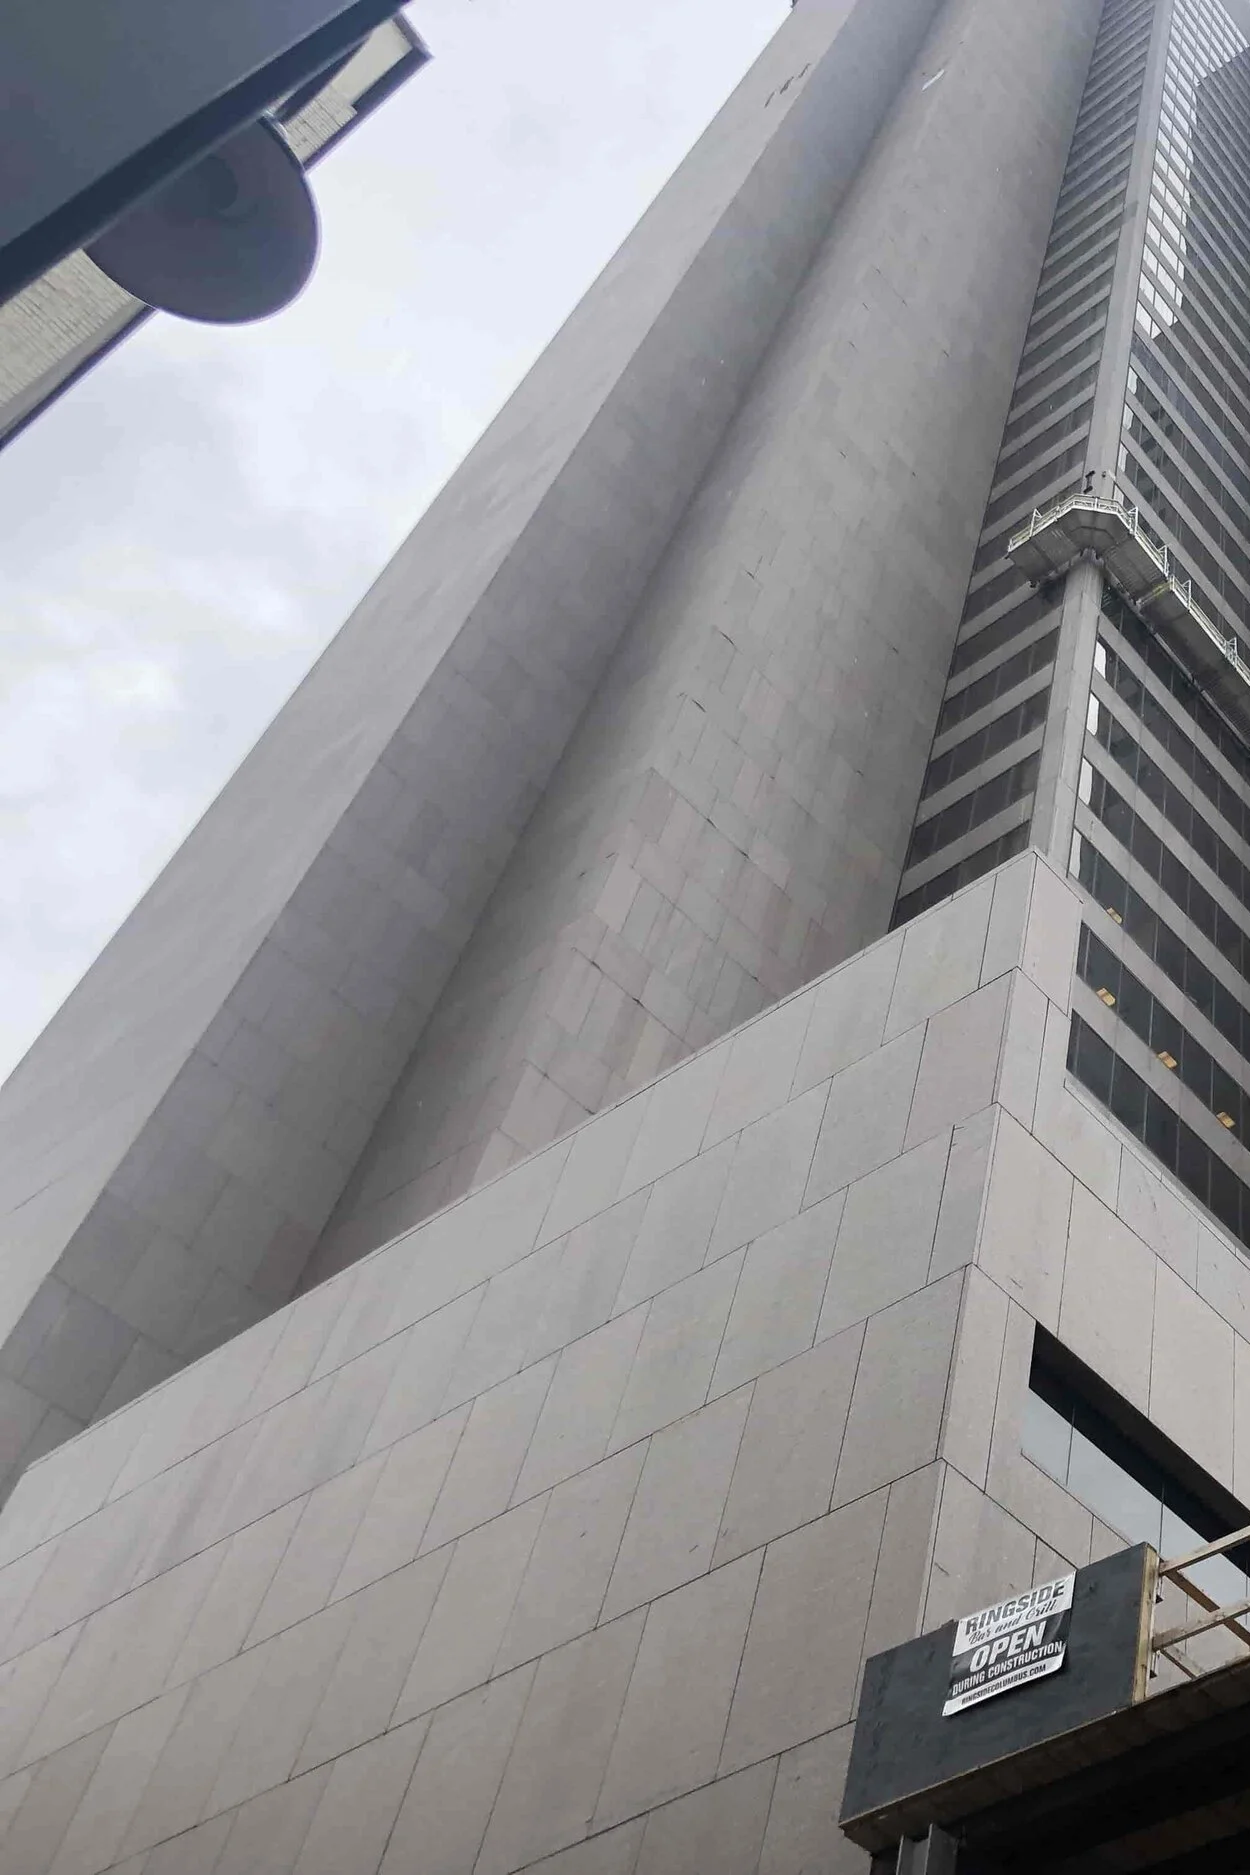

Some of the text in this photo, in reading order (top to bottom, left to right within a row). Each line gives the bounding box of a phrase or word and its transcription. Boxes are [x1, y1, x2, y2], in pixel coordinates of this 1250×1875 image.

[965, 1580, 1066, 1635] RINGSIDE
[968, 1599, 1058, 1645] Bar and Grill
[952, 1640, 1063, 1696] DURING CONSTRUCTION
[970, 1620, 1047, 1673] OPEN
[961, 1663, 1047, 1706] RINGSIDECOLUMBUS.COM
